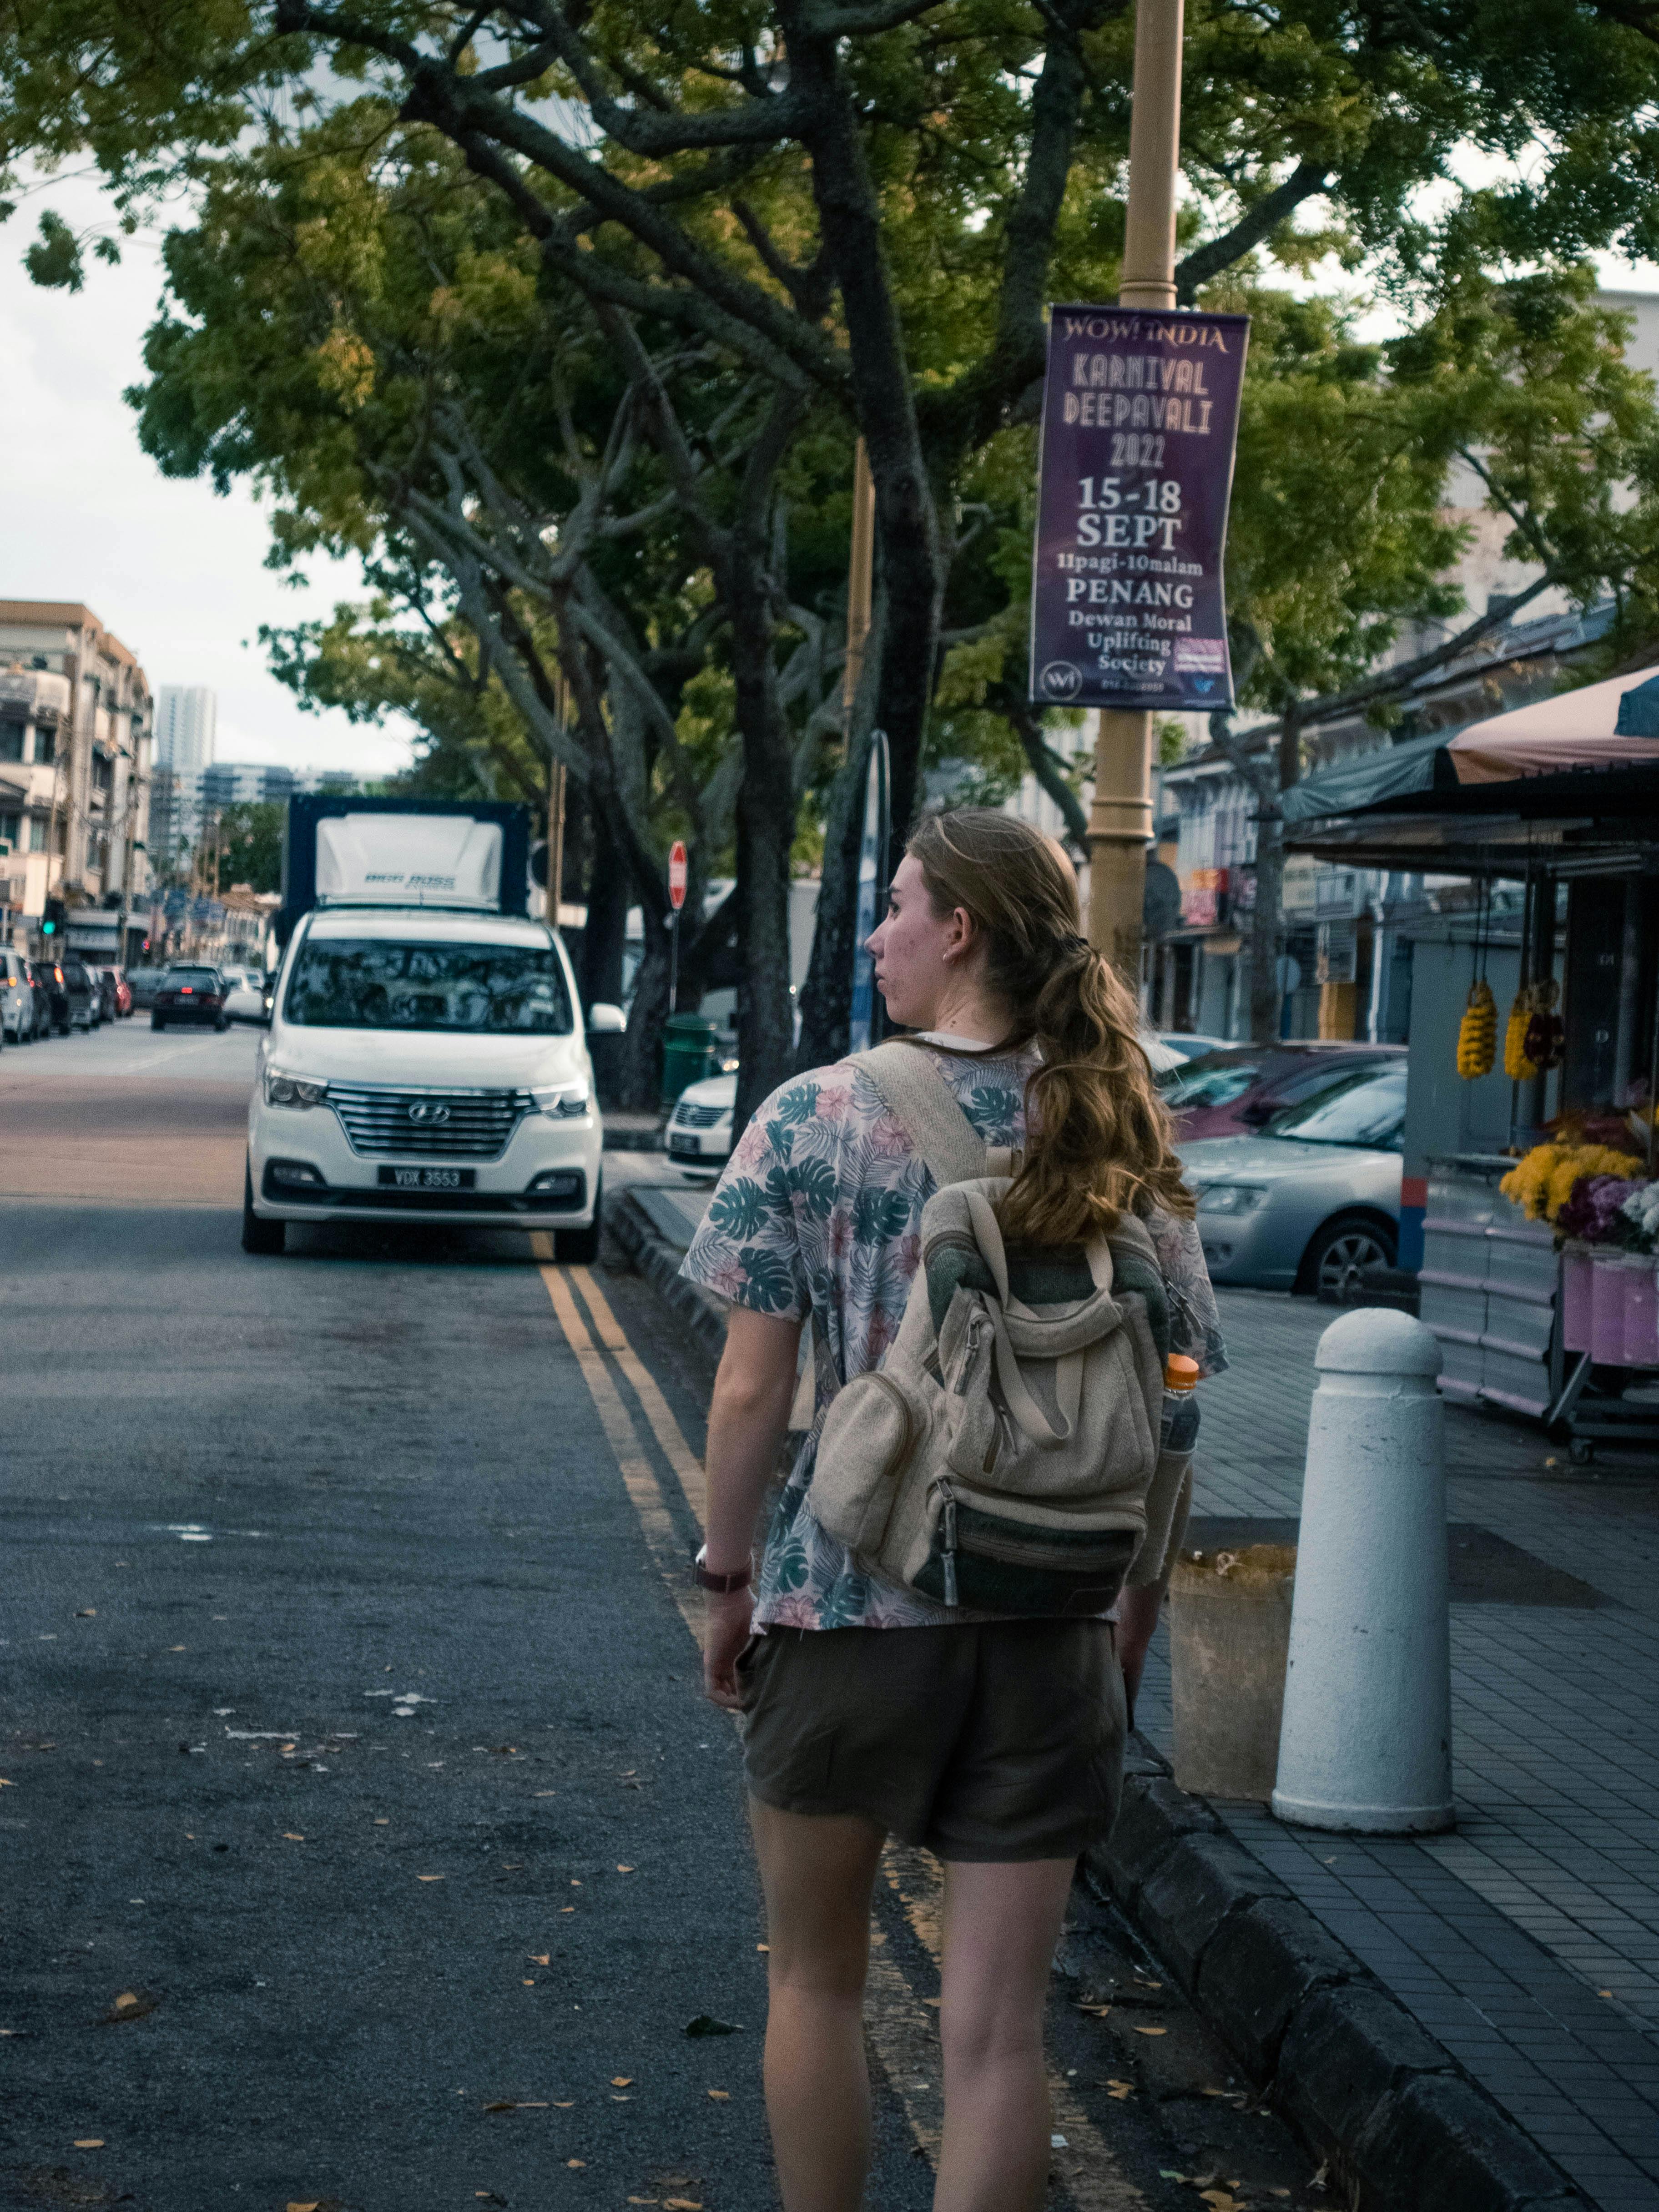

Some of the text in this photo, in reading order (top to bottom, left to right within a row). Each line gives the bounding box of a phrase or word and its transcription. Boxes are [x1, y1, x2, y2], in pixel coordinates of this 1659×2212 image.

[1146, 320, 1229, 353] INDIA
[1073, 353, 1208, 394] KARNIVAL
[1063, 391, 1213, 434] DEEPAVALI
[1078, 476, 1182, 514] 15-18
[1076, 513, 1182, 551] SEPT
[1066, 578, 1194, 609] PENANG
[1069, 610, 1192, 633] Dewan Moral
[1087, 632, 1172, 658] Uplifting
[1098, 653, 1167, 676] Society
